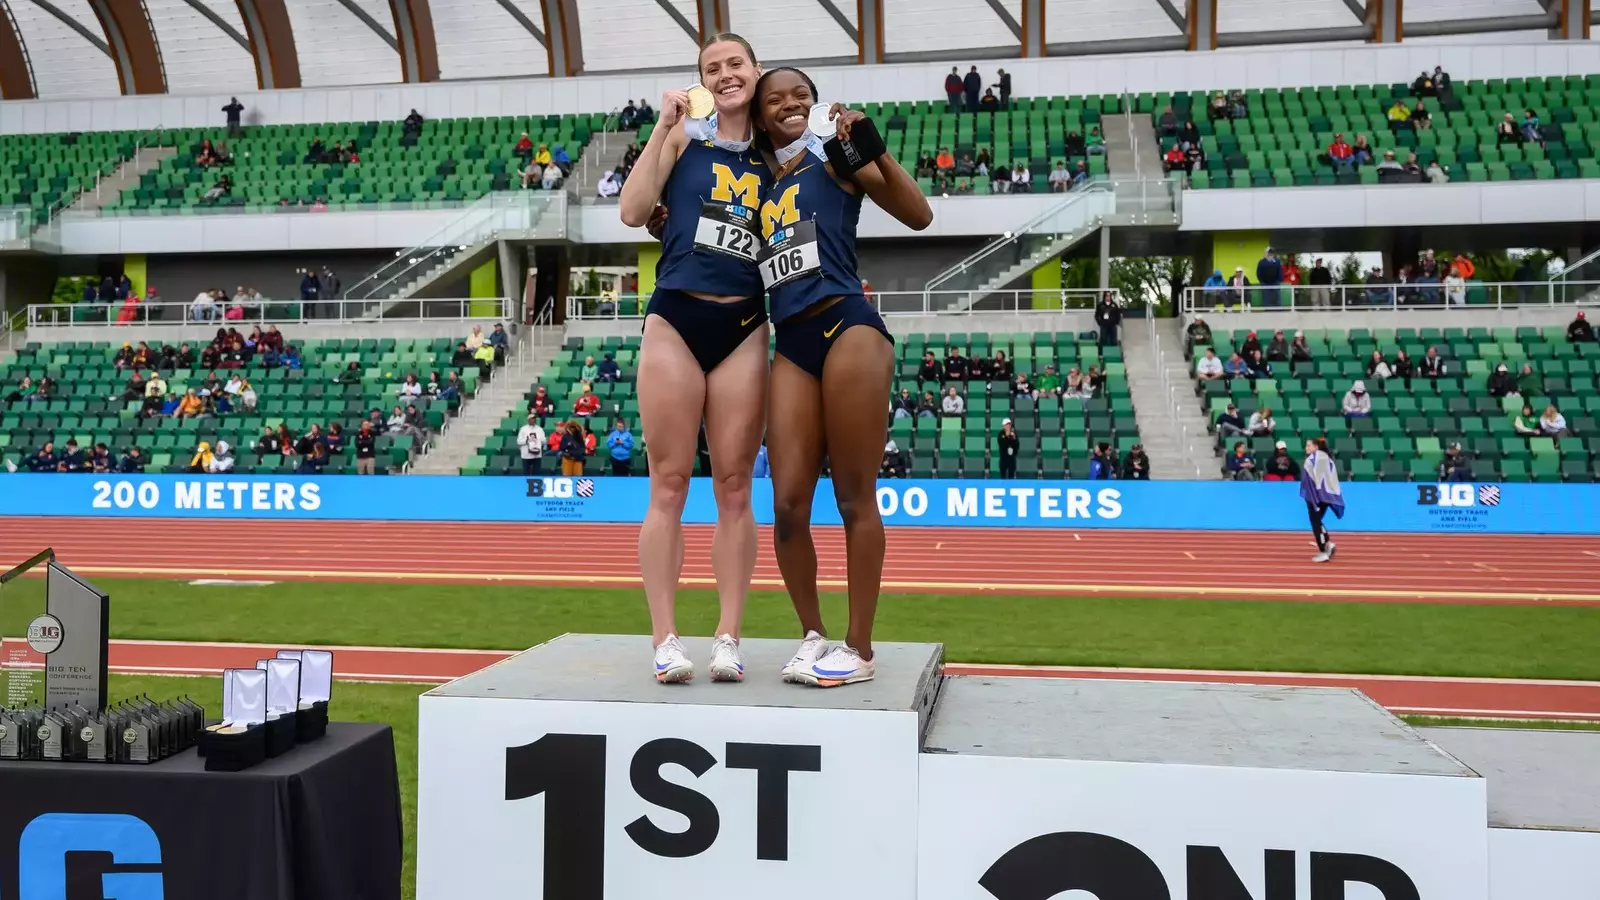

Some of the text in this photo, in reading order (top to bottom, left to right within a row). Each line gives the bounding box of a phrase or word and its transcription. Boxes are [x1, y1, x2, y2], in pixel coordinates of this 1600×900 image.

[711, 162, 761, 211] M
[760, 183, 800, 241] M
[715, 224, 753, 257] 122
[768, 248, 804, 282] 106
[92, 480, 321, 511] 200 METERS
[876, 486, 1123, 519] 00 METERS
[504, 732, 822, 900] 1ST
